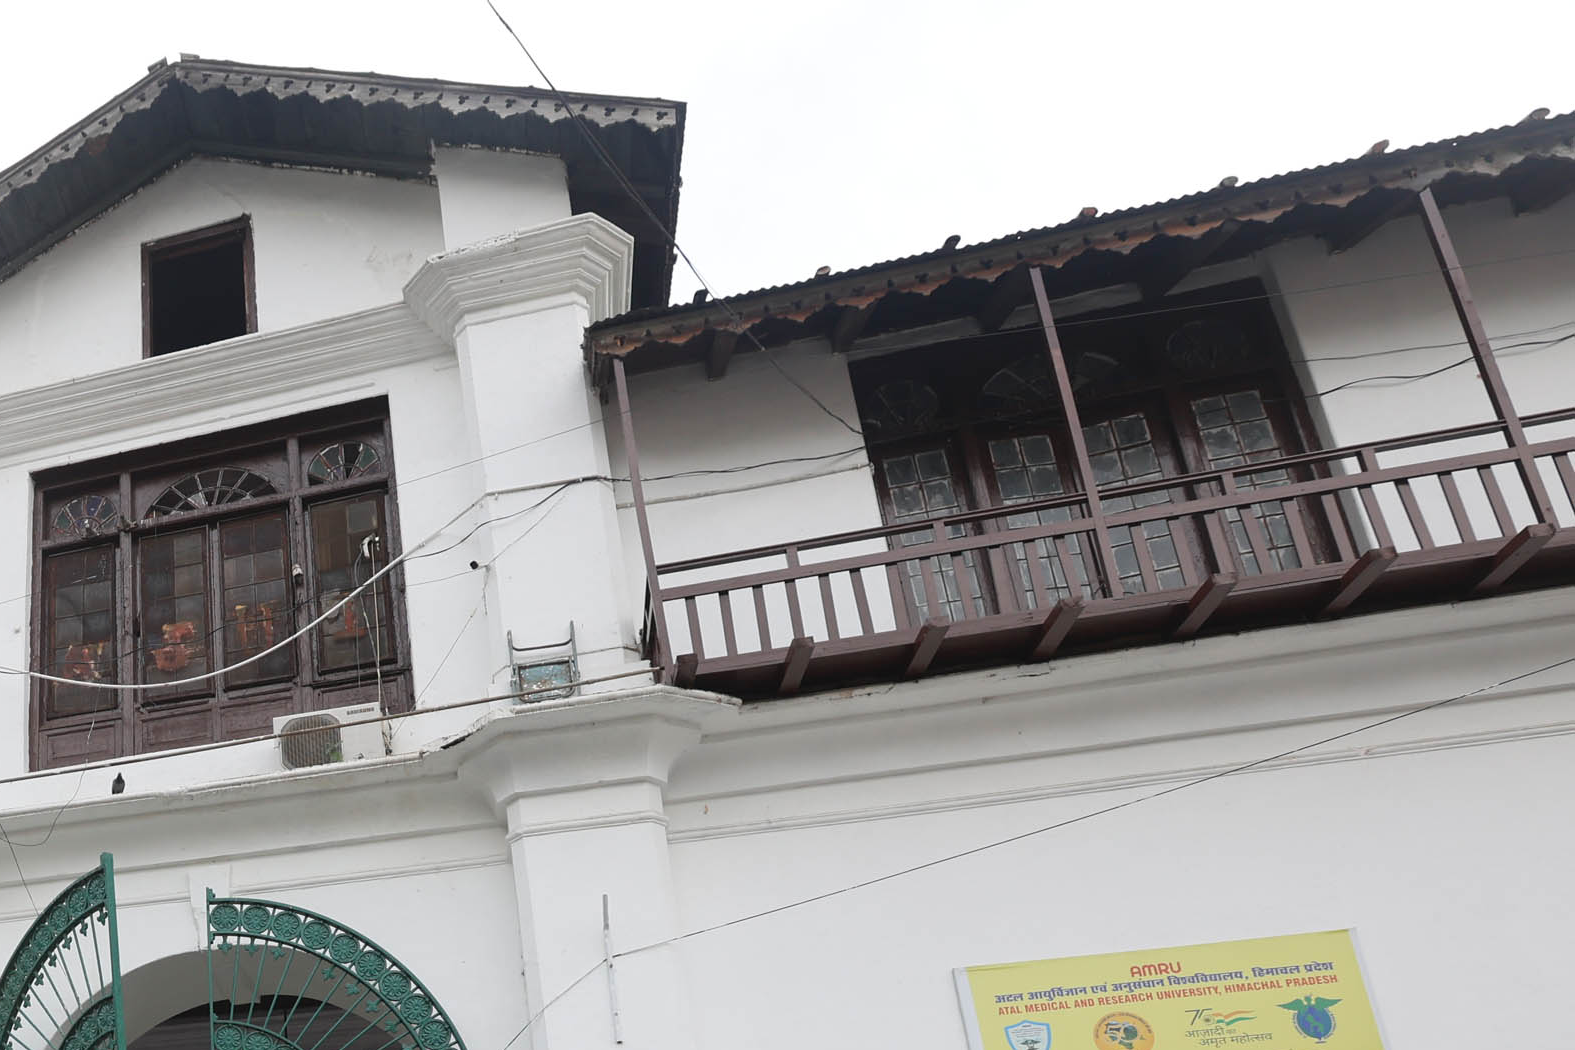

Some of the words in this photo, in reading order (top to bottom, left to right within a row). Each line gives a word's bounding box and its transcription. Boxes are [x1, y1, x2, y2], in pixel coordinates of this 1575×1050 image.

[994, 992, 1024, 1004] अटल
[1091, 981, 1108, 994] एवं
[1111, 977, 1165, 993] अनुसंधान
[1251, 964, 1300, 978] हिमाचल
[1303, 960, 1335, 973] प्रदेश
[1130, 961, 1182, 978] AMRU
[998, 1006, 1022, 1016] ATAL
[1025, 1001, 1071, 1013] MEDICAL
[1074, 998, 1095, 1008] AND
[1098, 991, 1154, 1006] RESEARCH
[1156, 985, 1222, 1001] UNIVERSITY,
[1224, 980, 1284, 994] HIMACHAL
[1286, 974, 1338, 988] PRADESH
[1199, 1034, 1227, 1048] अमृत
[1229, 1030, 1273, 1045] महोत्सव
